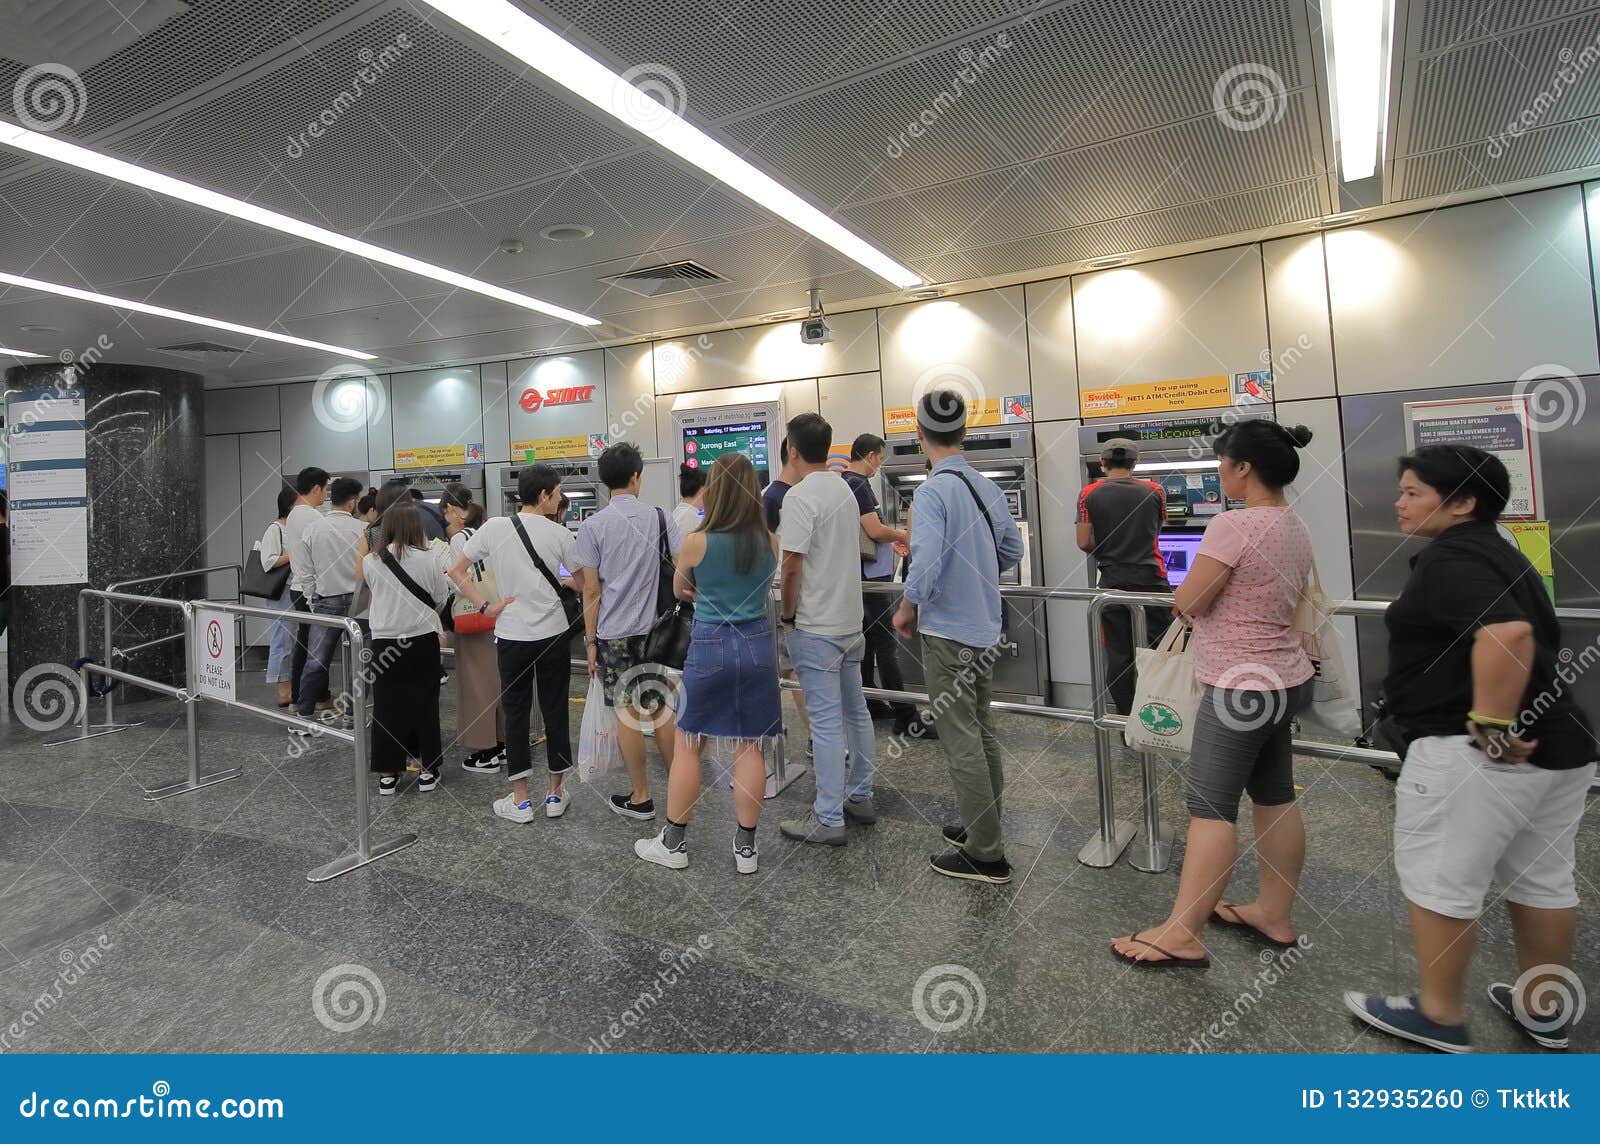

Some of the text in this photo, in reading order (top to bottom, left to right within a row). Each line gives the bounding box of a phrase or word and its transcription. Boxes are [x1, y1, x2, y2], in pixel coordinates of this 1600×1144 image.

[543, 385, 595, 406] SMRT
[1140, 428, 1201, 440] Welcome
[206, 663, 222, 676] PLEASE
[200, 674, 231, 689] DO NOT LEAN
